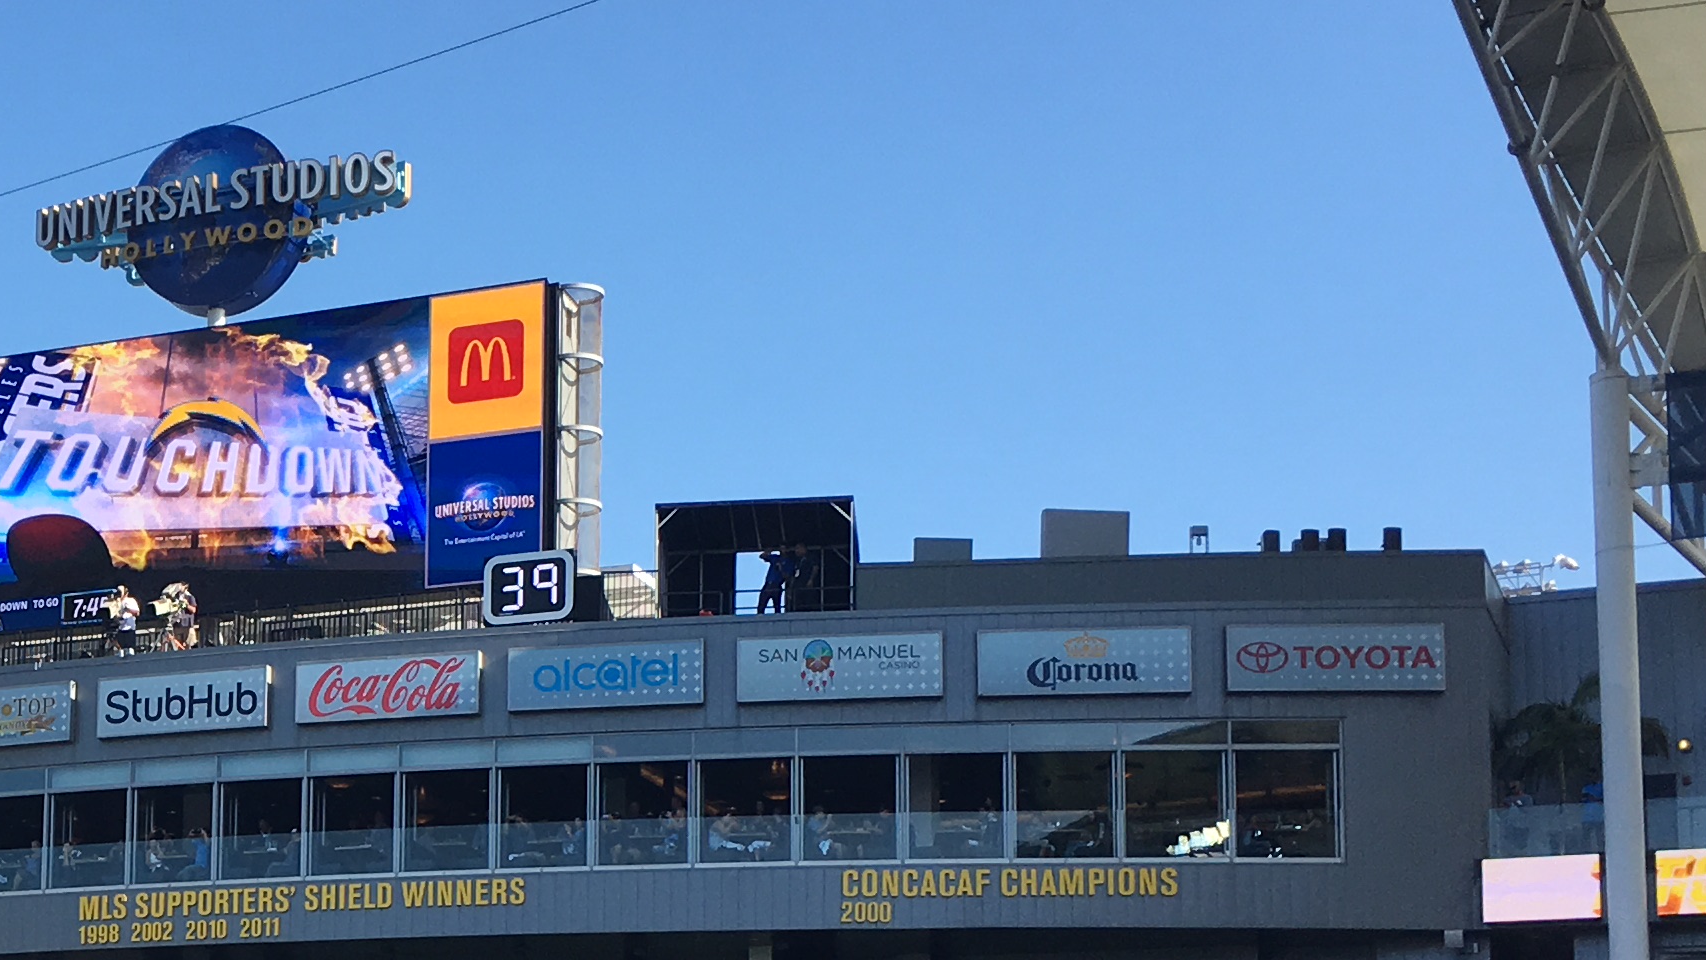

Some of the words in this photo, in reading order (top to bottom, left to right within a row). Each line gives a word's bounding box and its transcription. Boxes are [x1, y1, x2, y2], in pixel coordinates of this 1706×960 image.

[36, 176, 221, 249] UNIVERSAL
[230, 150, 397, 211] STUDIOS
[100, 217, 314, 269] HOLLYWOOD
[435, 499, 490, 519] UNIVERSAL
[493, 494, 535, 510] STUDIOS
[502, 563, 558, 612] 39
[0, 600, 28, 613] DOWN
[33, 598, 45, 609] TO
[46, 597, 59, 608] GO
[758, 647, 798, 663] SAN
[837, 644, 921, 661] MANUEL
[878, 660, 921, 670] CASINO
[1292, 645, 1438, 670] TOYOTA
[308, 656, 466, 718] Coca-Cola
[533, 652, 679, 693] alcatel
[1026, 656, 1139, 691] Corona
[13, 695, 56, 717] TOP
[104, 682, 259, 725] StubHub
[842, 868, 992, 898] CONCACAF
[1000, 867, 1179, 898] CHAMPIONS
[78, 893, 128, 921] MLS
[134, 886, 296, 918] SUPPORTERS'
[304, 882, 393, 912] SHIELD
[401, 877, 526, 908] WINNERS
[840, 901, 892, 924] 2000
[78, 925, 120, 945] 1998
[131, 922, 173, 943] 2002
[186, 920, 227, 940] 2010
[239, 918, 281, 938] 2011
